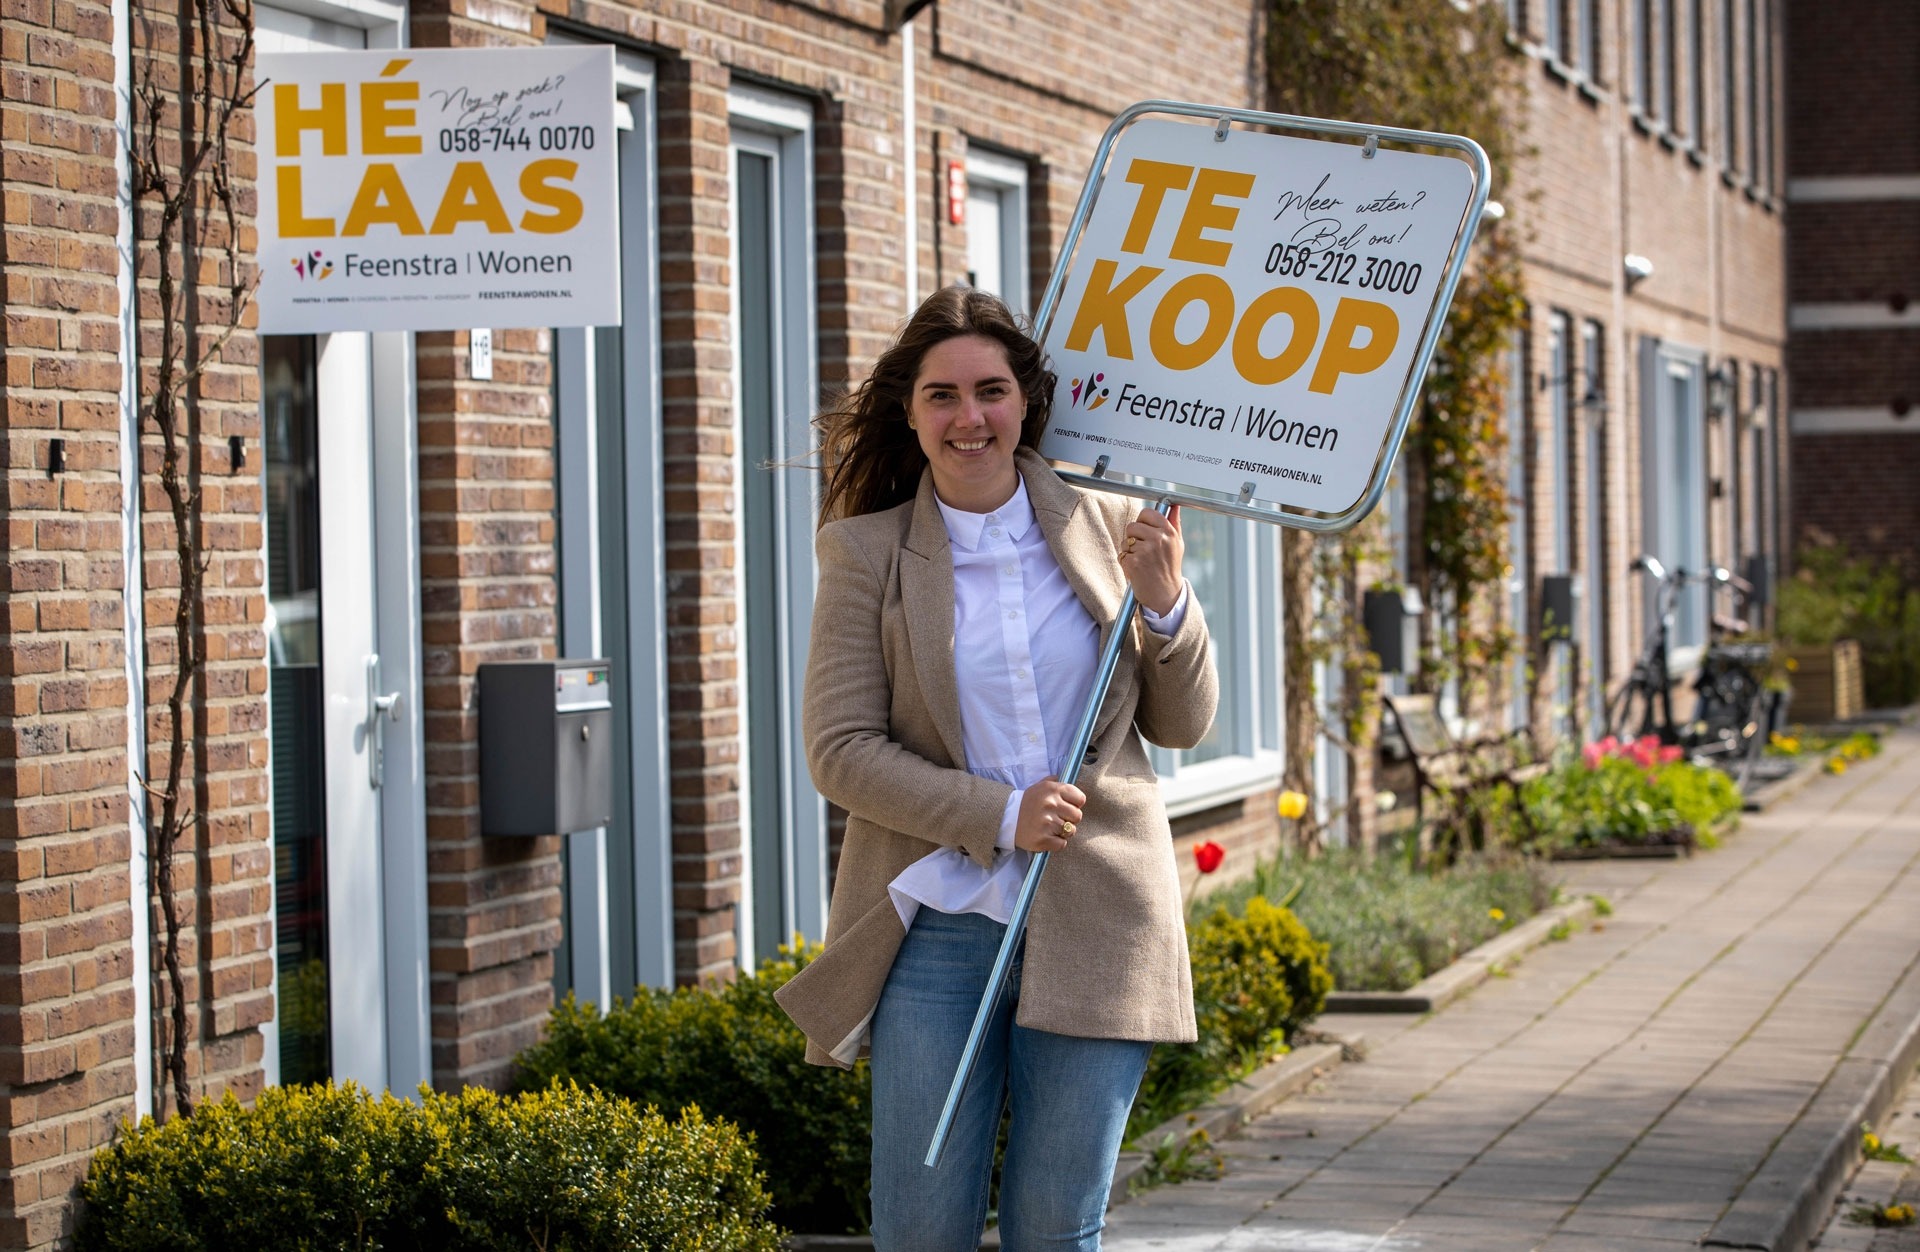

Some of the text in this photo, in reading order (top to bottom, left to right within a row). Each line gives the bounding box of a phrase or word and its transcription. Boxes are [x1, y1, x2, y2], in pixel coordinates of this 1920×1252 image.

[274, 59, 423, 157] HÉ
[440, 126, 595, 152] 058-744 0070
[276, 158, 584, 238] LAAS
[1120, 158, 1257, 267] TE
[1273, 173, 1427, 220] Meer weten?
[1291, 218, 1413, 254] Bel ons!
[345, 254, 458, 277] Feenstra
[478, 250, 573, 274] Wonen
[1265, 243, 1422, 295] 058-212 3000
[478, 290, 573, 300] FEENSTRAWONEN.NL
[1064, 258, 1400, 395] KOOP
[1115, 383, 1225, 430] Feenstra
[1246, 405, 1339, 451] Wonen
[1053, 428, 1080, 438] FEENSTRA
[1085, 433, 1107, 444] WONEN
[1113, 439, 1143, 451] ONDERDEEL
[1155, 446, 1181, 458] FEENSTRA
[1185, 453, 1223, 466] ADVIESGROEP
[1229, 458, 1323, 485] FEENSTRAWONEN.NL
